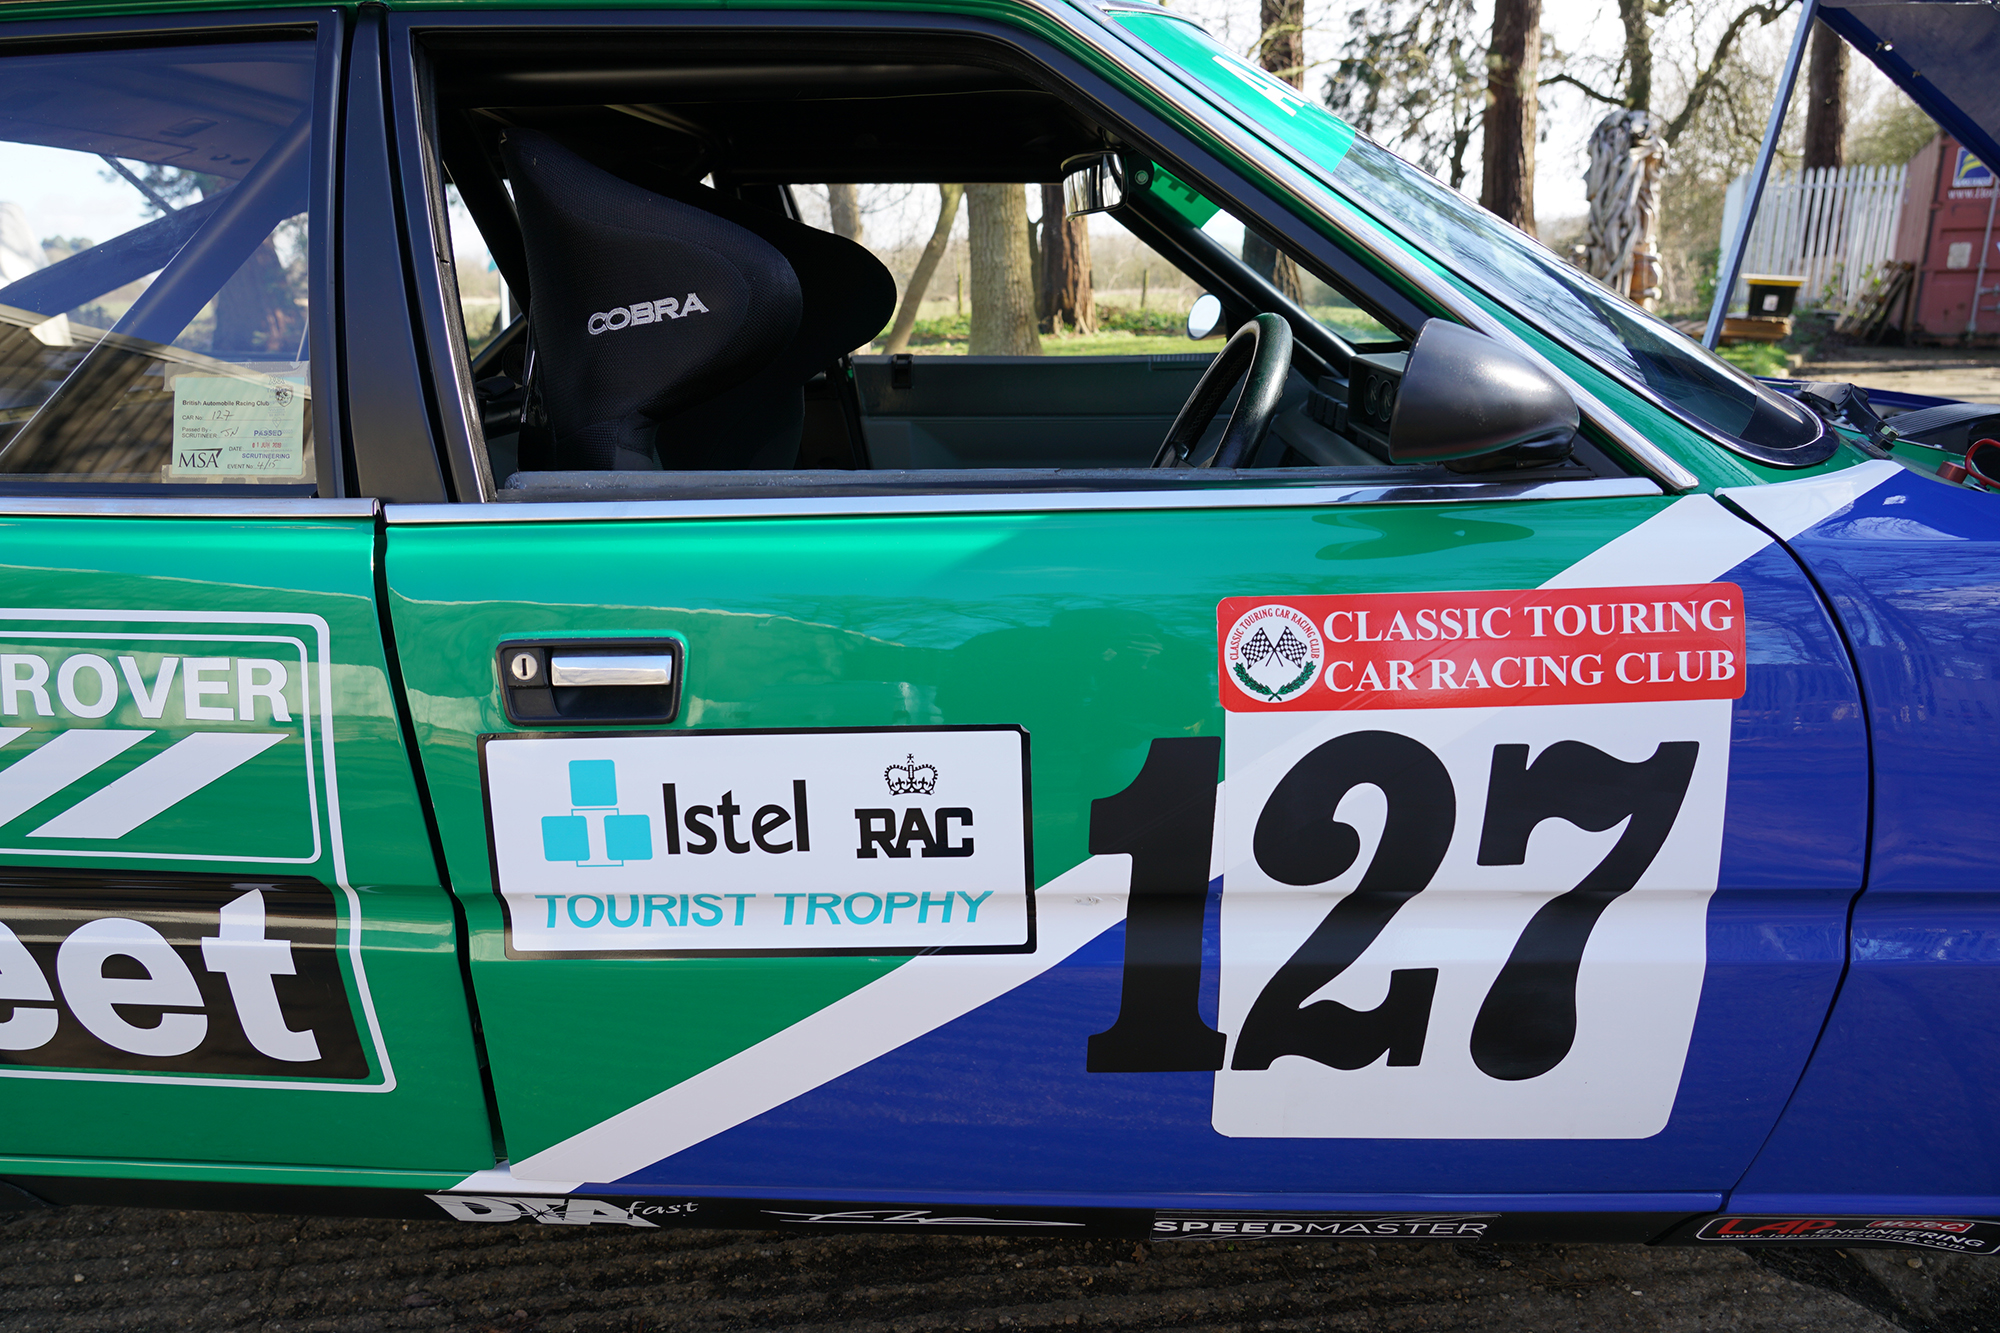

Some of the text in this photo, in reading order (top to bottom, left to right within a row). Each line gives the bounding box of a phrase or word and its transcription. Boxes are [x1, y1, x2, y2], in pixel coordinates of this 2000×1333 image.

[587, 292, 710, 335] COBRA
[211, 409, 235, 421] 127
[253, 429, 283, 437] PASSED
[178, 452, 220, 469] MSA
[1229, 607, 1320, 661] CLASSIC TOURING CAR RACING CLUB
[1323, 598, 1733, 644] CLASSIC TOURING
[0, 653, 293, 723] ROVER
[1324, 649, 1736, 693] CAR RACING CLUB
[662, 779, 811, 855] Istel
[854, 807, 975, 859] RAC
[534, 890, 995, 929] TOURIST TROPHY
[1086, 729, 1700, 1081] 127
[1152, 1221, 1489, 1235] SPEEDMASTER
[1716, 1218, 1838, 1235] LAP
[1720, 1233, 1966, 1250] www.lapengineering.com
[1814, 1228, 1986, 1248] ENGINEERING
